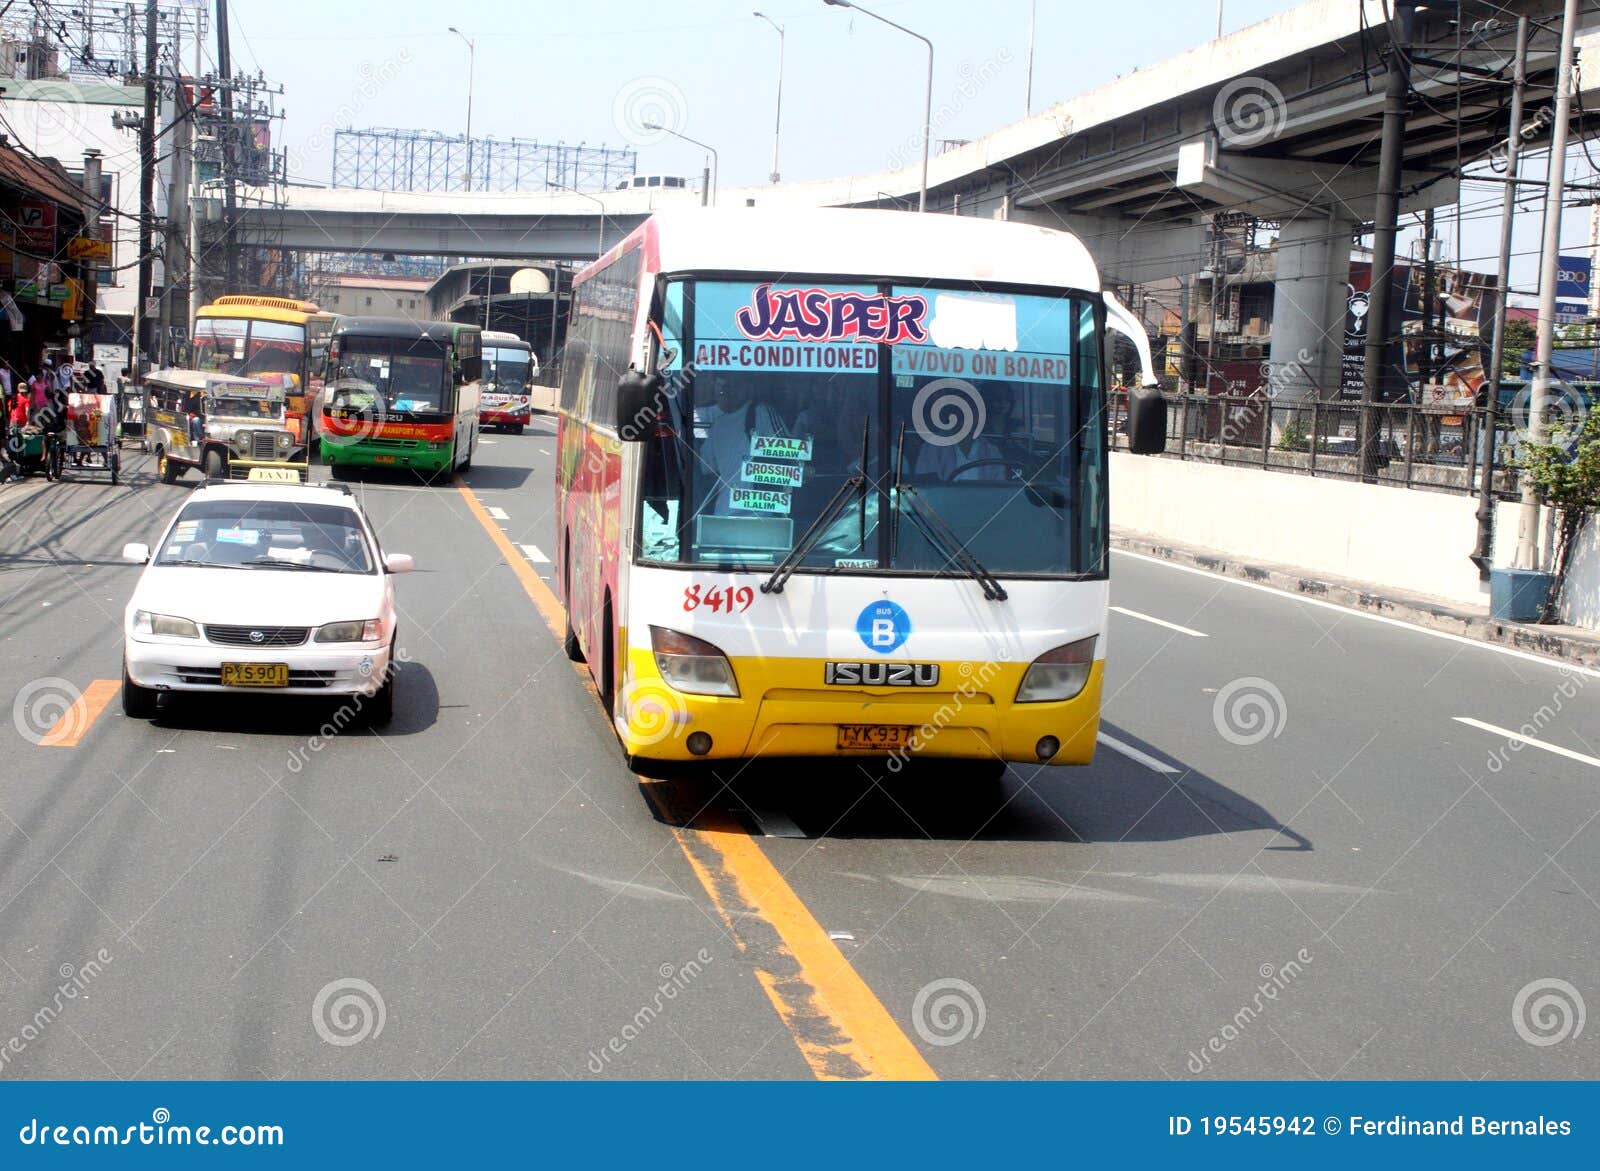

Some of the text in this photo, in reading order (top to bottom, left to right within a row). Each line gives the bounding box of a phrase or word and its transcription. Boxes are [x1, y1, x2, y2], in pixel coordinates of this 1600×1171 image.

[1557, 270, 1587, 283] BDO
[736, 283, 928, 344] JASPER
[695, 344, 877, 369] AIR-CONDITIONED
[971, 355, 997, 376] ON
[1004, 356, 1069, 380] BOARD
[754, 436, 809, 453] AYALA
[762, 448, 800, 458] IBABAW
[745, 462, 800, 481] CROSSING
[754, 474, 791, 485] IBABAW
[682, 584, 755, 614] 8419
[872, 618, 896, 647] B
[826, 663, 938, 685] ISUZU
[841, 726, 911, 742] TYK-937
